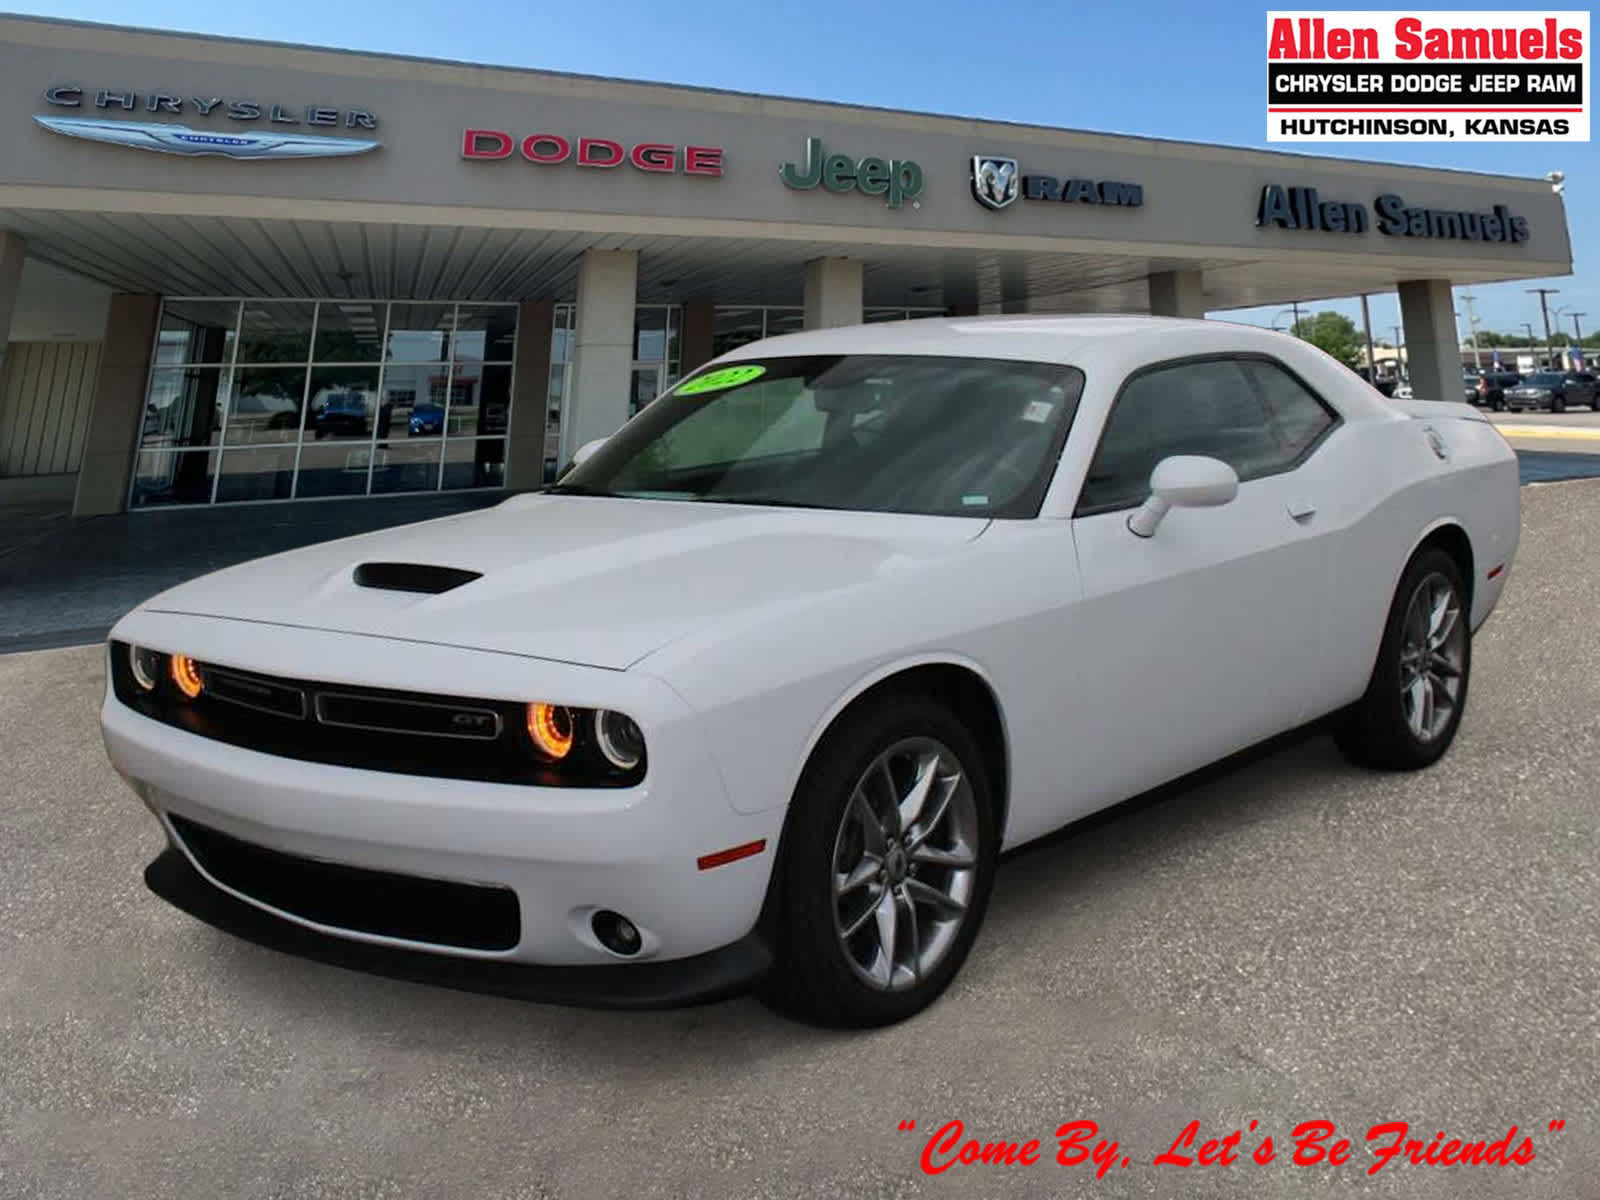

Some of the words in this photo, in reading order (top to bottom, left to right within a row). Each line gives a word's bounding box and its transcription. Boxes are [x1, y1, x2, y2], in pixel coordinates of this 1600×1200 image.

[43, 86, 377, 129] CHRYSLER
[460, 127, 724, 176] DODGE
[779, 136, 923, 209] Jeep
[1023, 174, 1143, 207] RAM
[1256, 183, 1369, 234] Allen
[1374, 193, 1530, 243] Samuels
